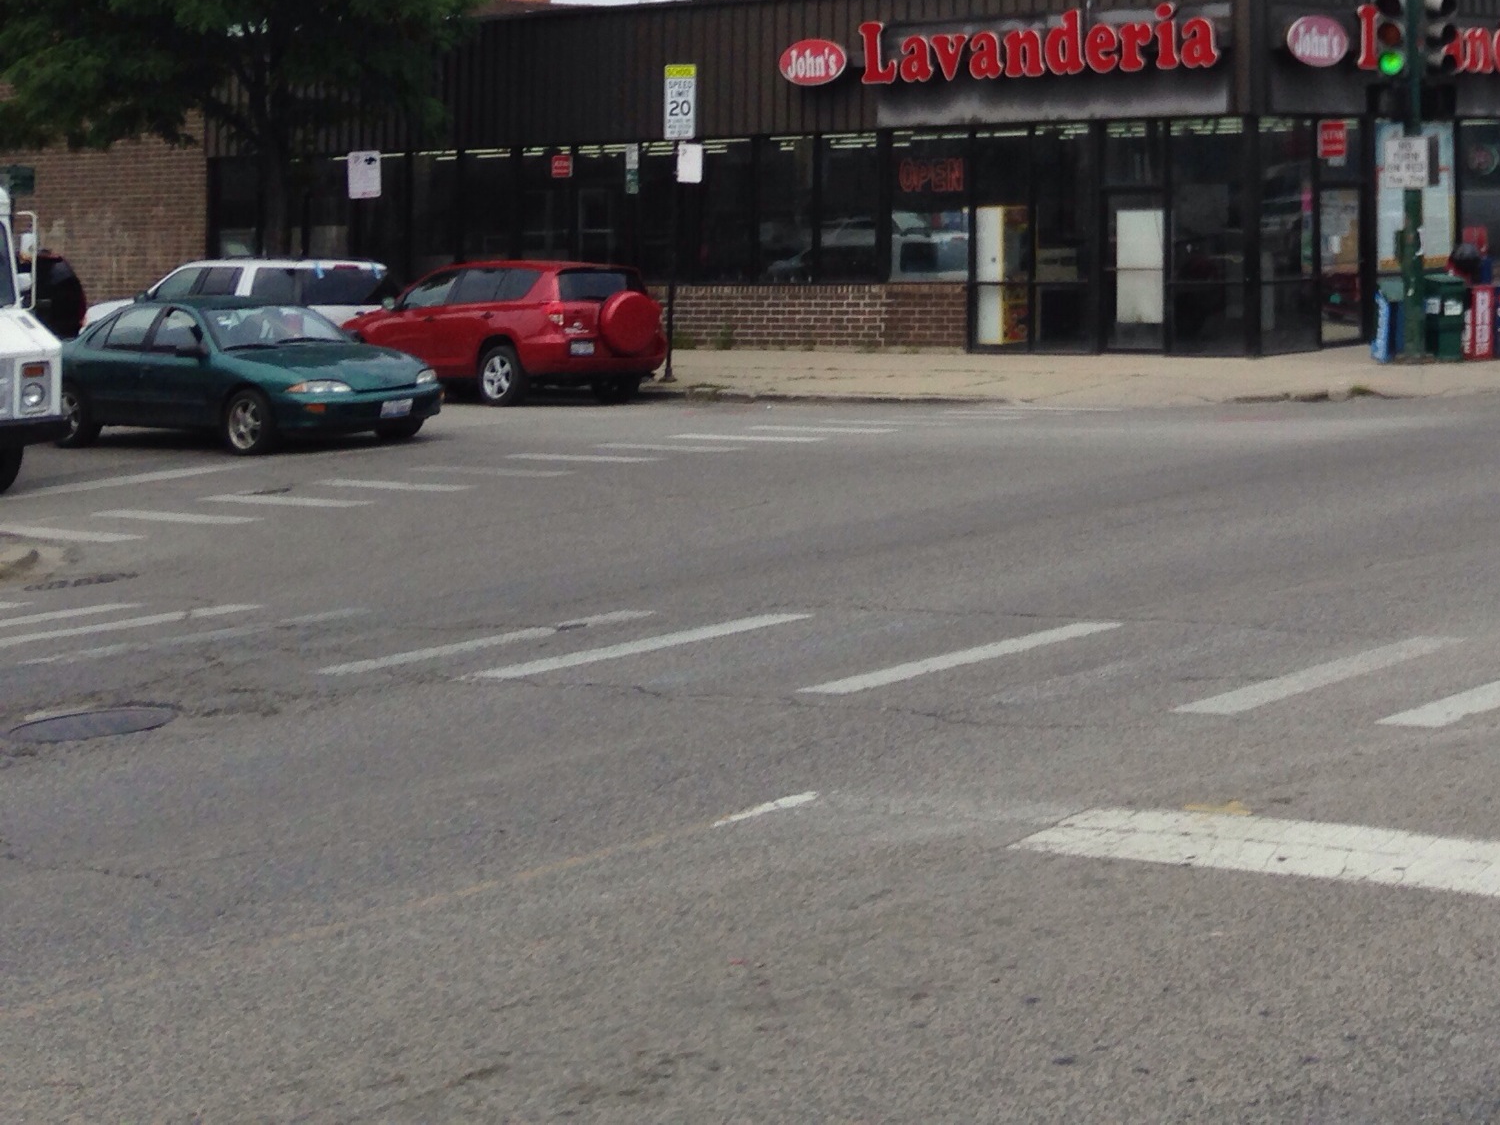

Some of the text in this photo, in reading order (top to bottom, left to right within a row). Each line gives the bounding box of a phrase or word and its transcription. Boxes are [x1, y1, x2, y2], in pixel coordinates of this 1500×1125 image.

[783, 4, 1219, 86] John's Lavanderia
[1293, 23, 1341, 58] John's
[668, 80, 693, 89] SPEED
[670, 89, 690, 98] LIMIT
[669, 100, 691, 116] 20
[898, 157, 964, 193] OPEN
